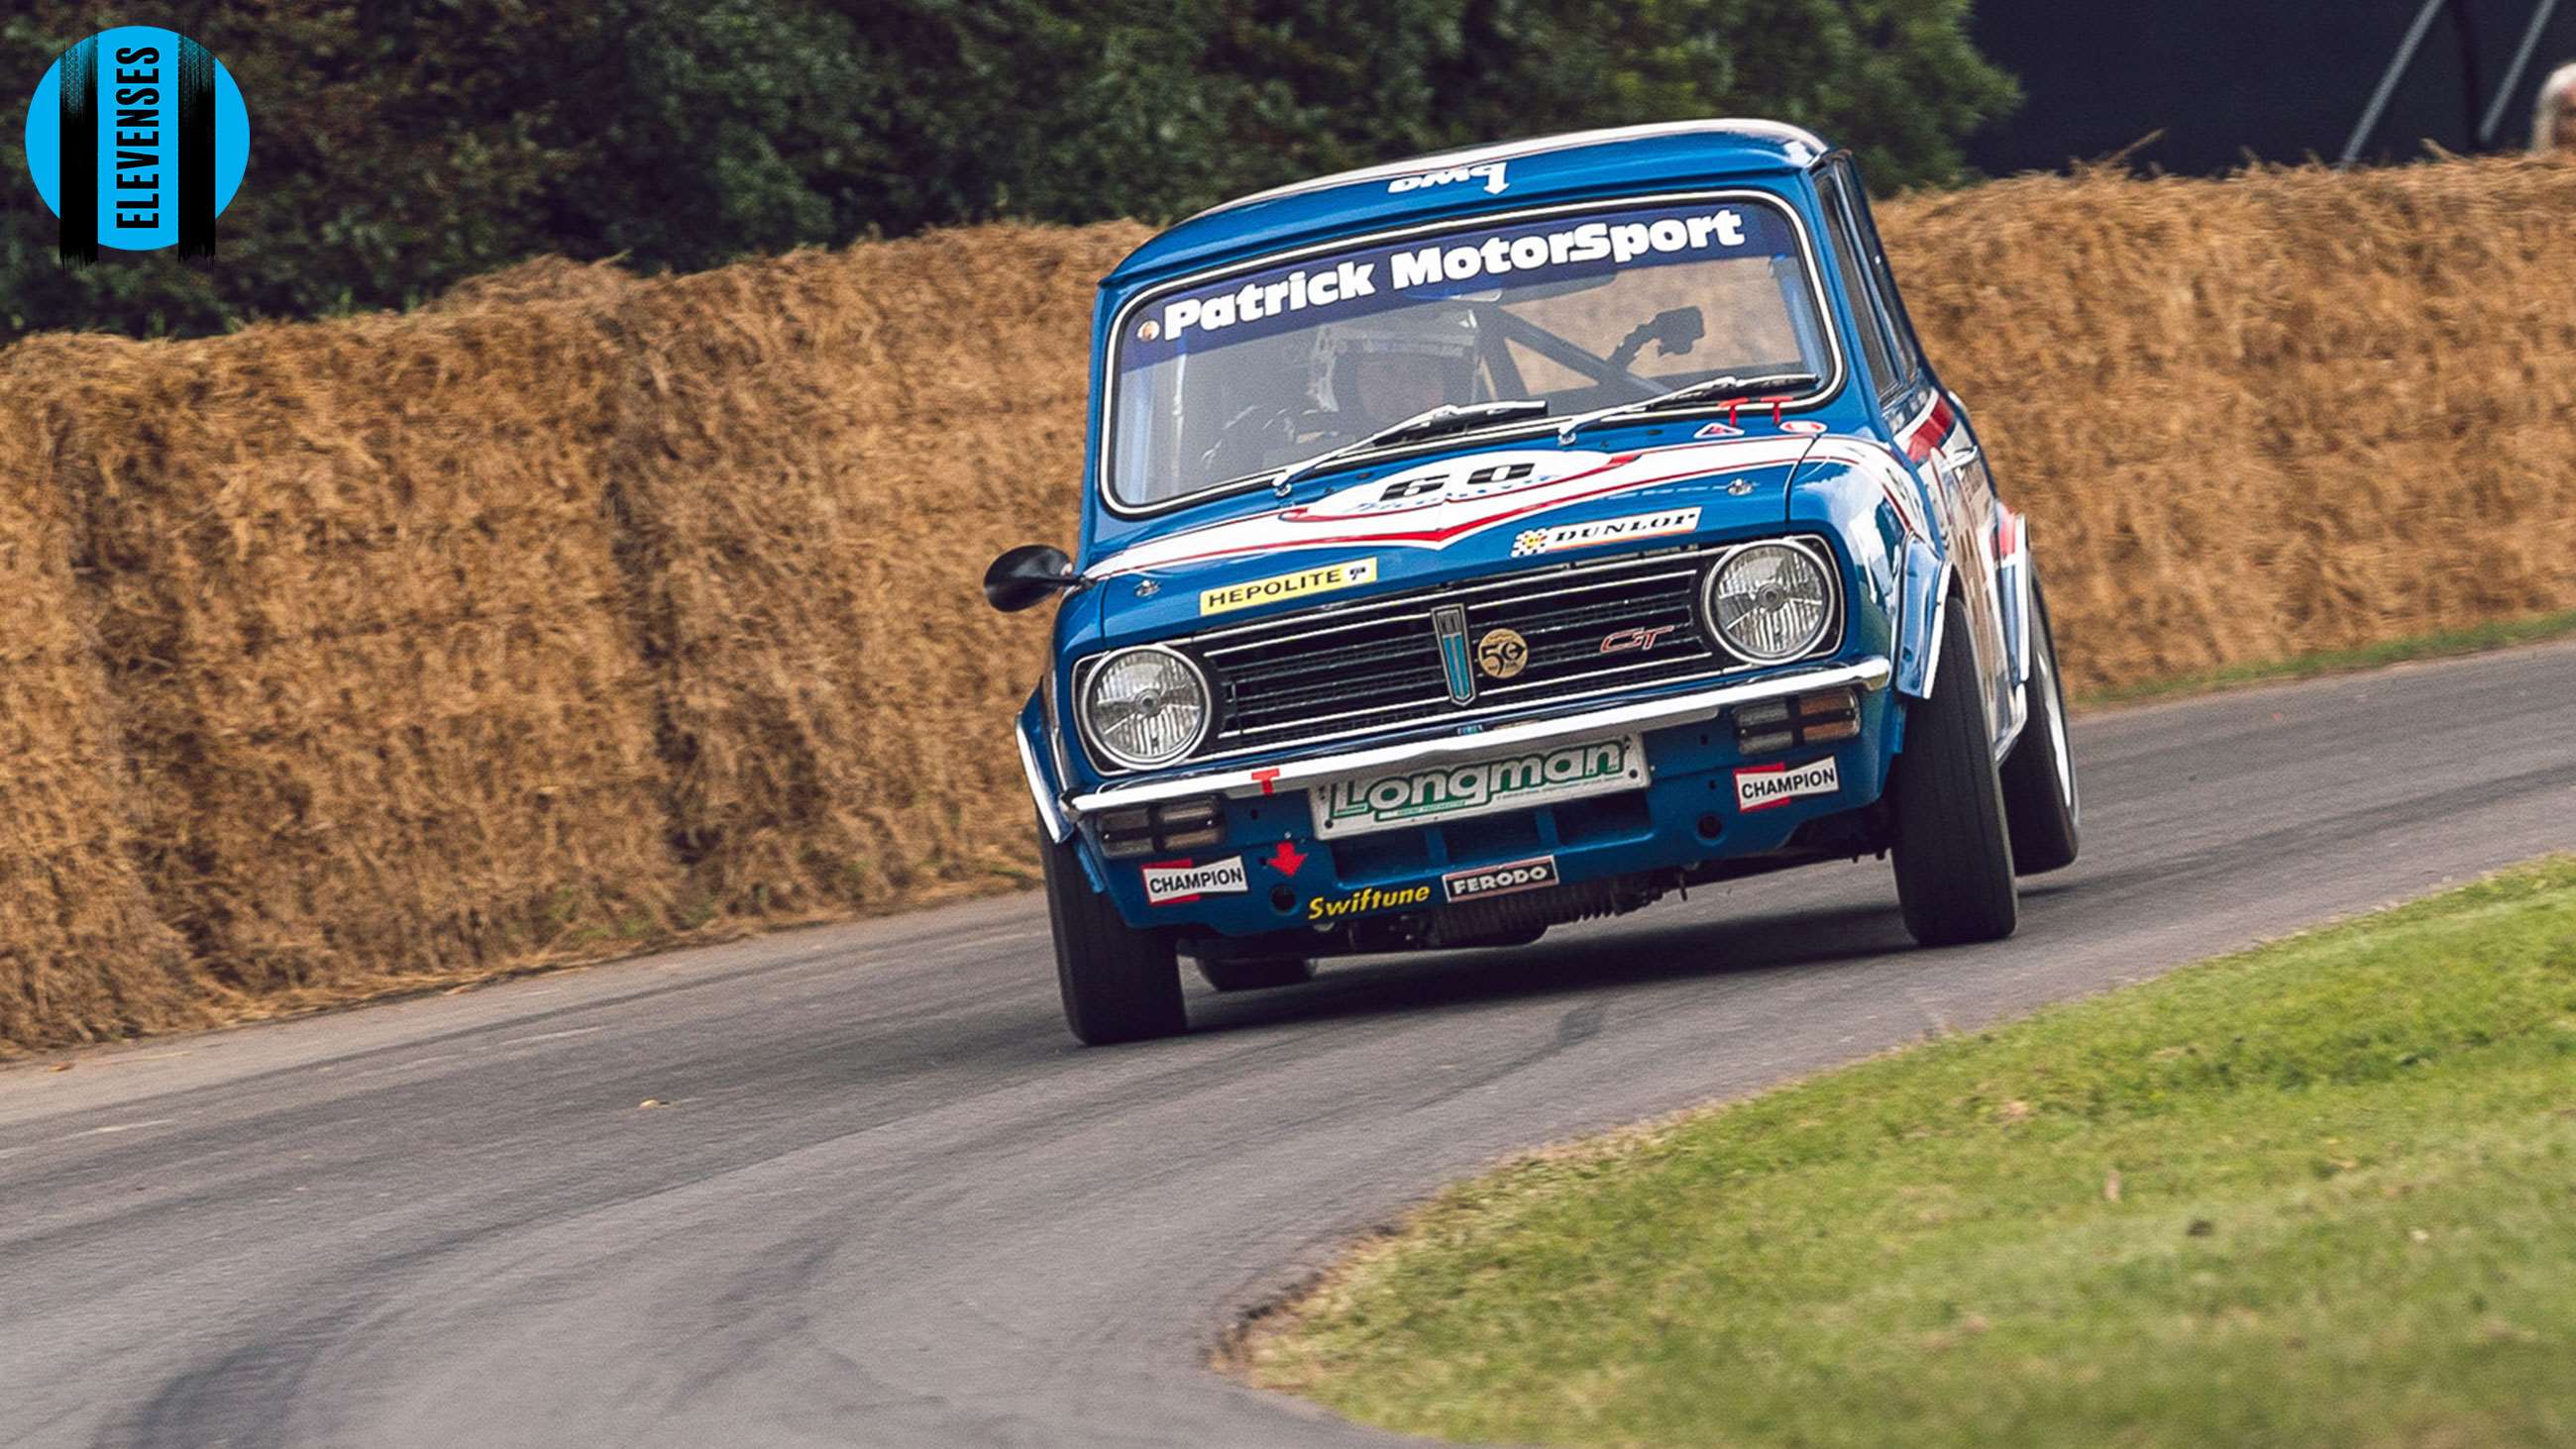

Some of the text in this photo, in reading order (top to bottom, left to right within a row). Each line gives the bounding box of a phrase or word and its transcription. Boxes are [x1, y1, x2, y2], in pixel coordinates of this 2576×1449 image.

[1164, 209, 1746, 341] Patrick MotorSport
[1379, 463, 1535, 502] 60
[1554, 513, 1696, 542] DUNLOP
[1209, 569, 1342, 608] HEPOLITE
[1600, 625, 1675, 654] GT
[1331, 740, 1626, 822] Longman
[1742, 768, 1835, 799] CHAMPION
[1148, 866, 1243, 894] CHAMPION
[1452, 864, 1549, 895] FERODO
[1308, 883, 1431, 920] Swiftune
